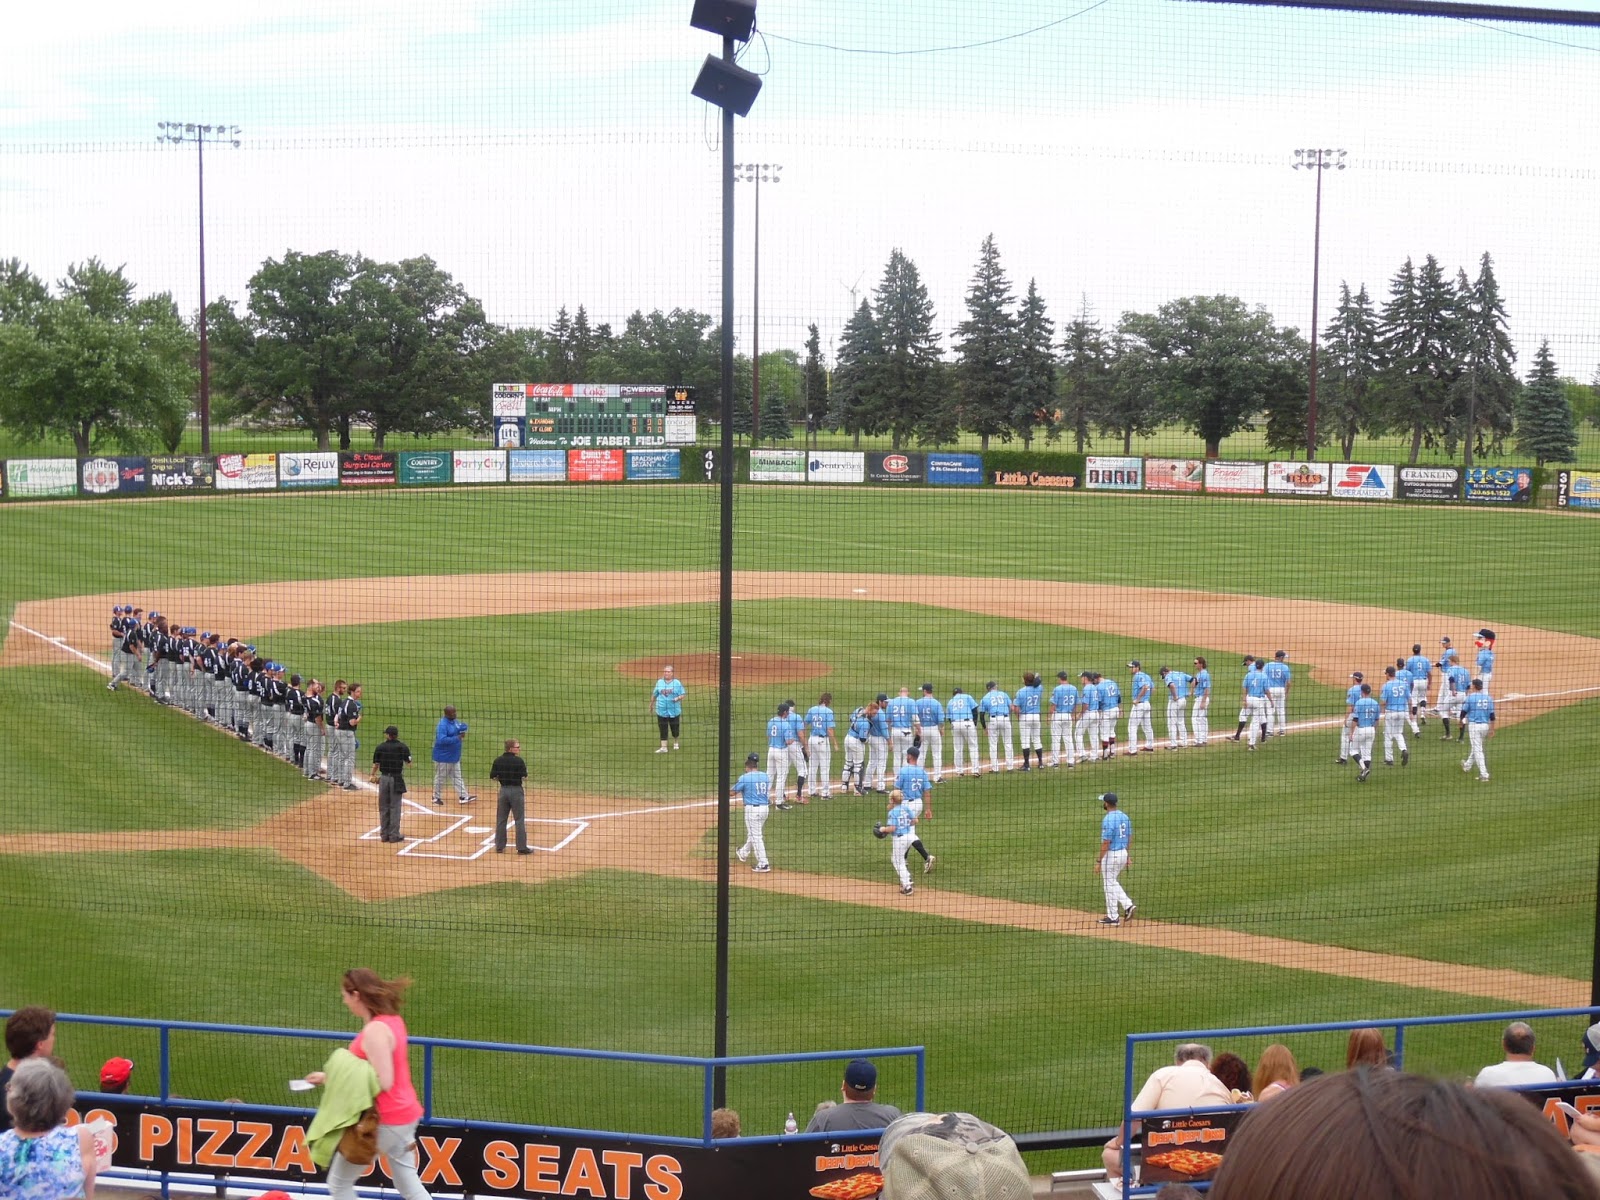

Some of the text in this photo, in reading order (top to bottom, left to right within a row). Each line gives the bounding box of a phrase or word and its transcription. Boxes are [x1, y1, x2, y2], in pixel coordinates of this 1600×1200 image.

[583, 386, 607, 397] Coke
[501, 428, 518, 440] Lite
[529, 437, 558, 445] Welcome
[559, 437, 568, 445] To
[571, 436, 591, 446] JOE
[596, 436, 631, 446] FABER
[635, 436, 665, 446] FIELD
[29, 464, 60, 474] Holiday
[303, 458, 336, 472] Rejuv
[343, 461, 370, 469] Surgical
[455, 458, 504, 470] Party City
[151, 472, 193, 486] Nick's
[995, 471, 1074, 488] Little Caesars
[1289, 474, 1321, 483] TEXAS
[1405, 470, 1453, 479] FRANKLIN
[1334, 488, 1390, 497] SUPERAMERICA
[1392, 686, 1404, 697] 55
[952, 699, 964, 711] 28
[1027, 695, 1039, 706] 27
[1063, 695, 1075, 705] 23
[893, 705, 905, 717] 24
[771, 725, 777, 737] 8
[755, 782, 766, 796] 18
[911, 778, 923, 791] 25
[1172, 1120, 1188, 1128] Little
[139, 1112, 317, 1174] PIZZA
[841, 1144, 859, 1152] Little
[481, 1139, 683, 1200] SEATS
